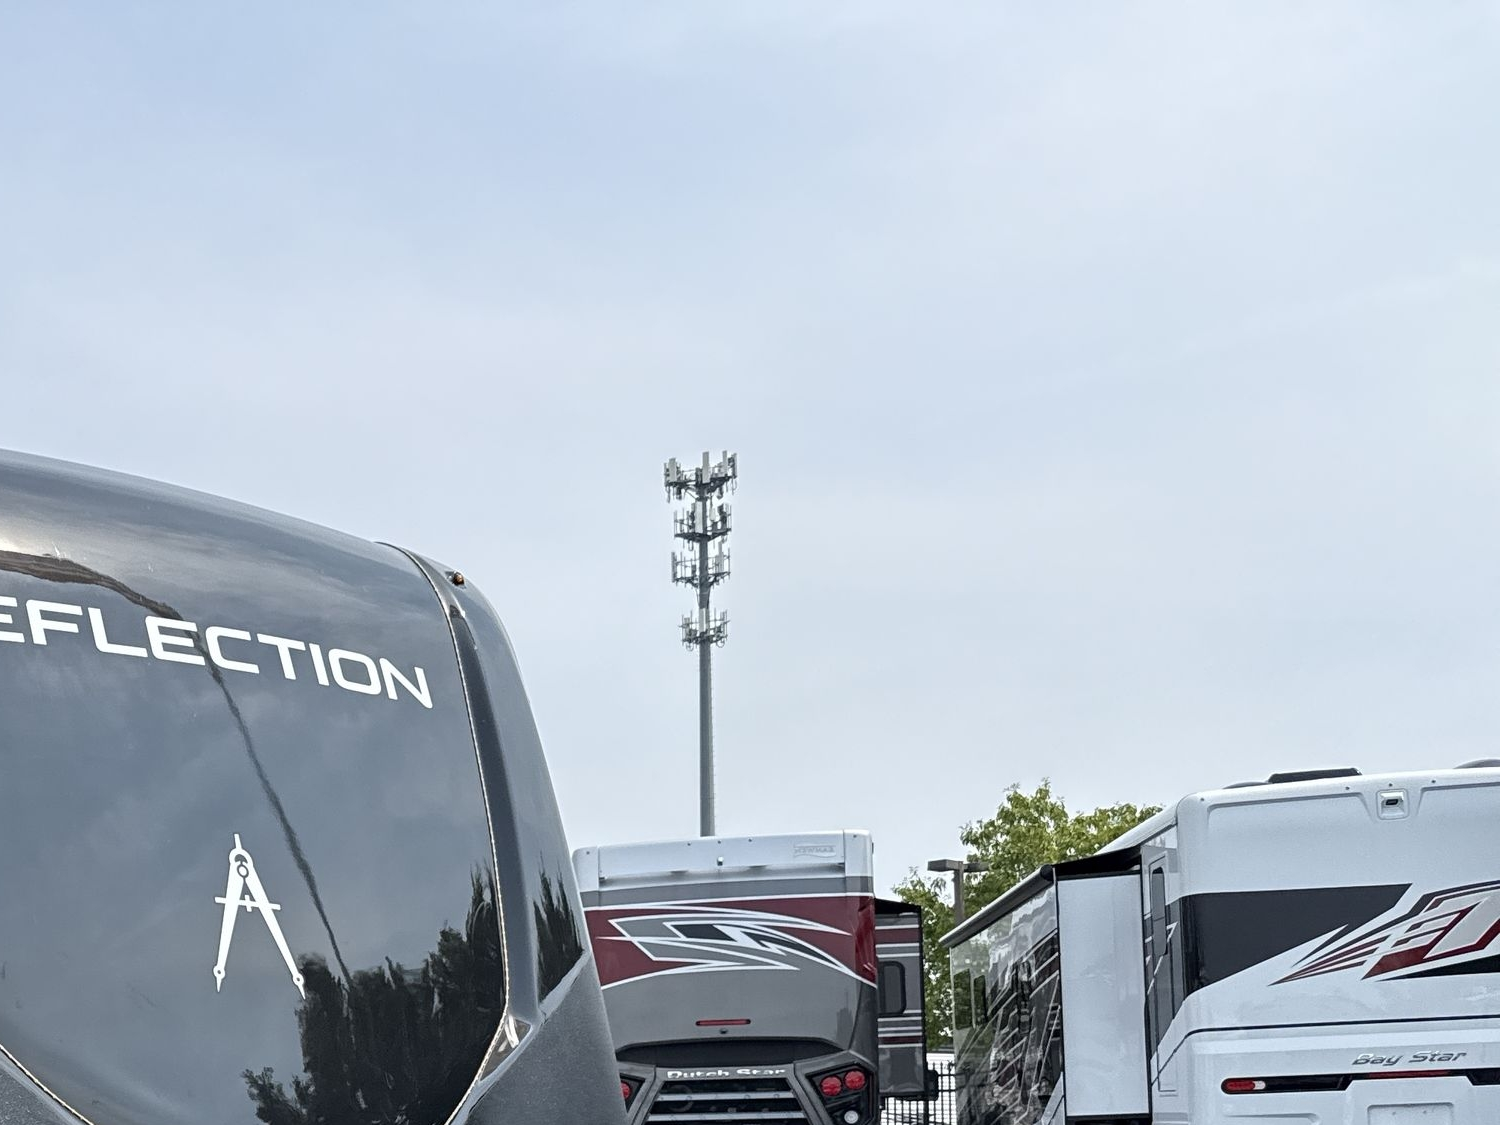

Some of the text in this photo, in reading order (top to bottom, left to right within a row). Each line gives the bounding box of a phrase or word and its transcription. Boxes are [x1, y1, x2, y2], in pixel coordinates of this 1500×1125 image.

[1352, 1050, 1467, 1067] Bay Star
[667, 1068, 786, 1079] Dutch Star
